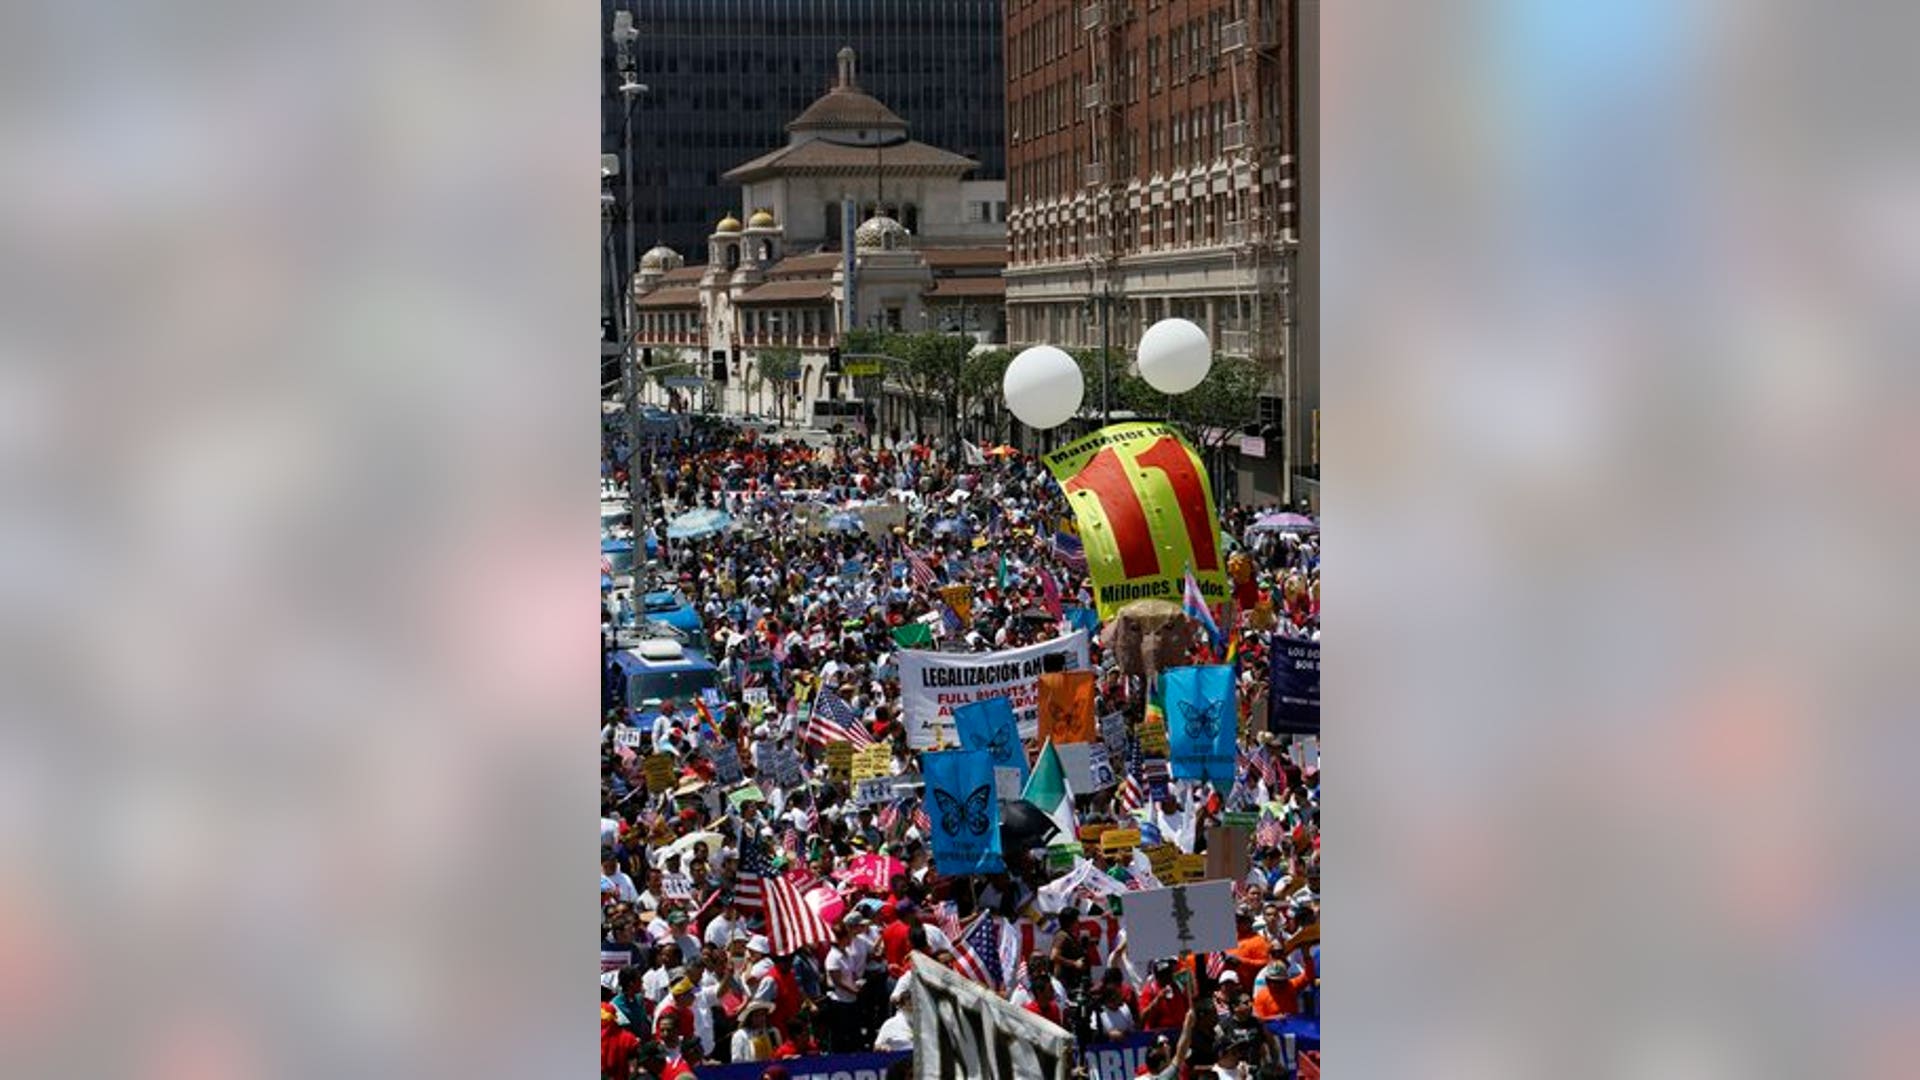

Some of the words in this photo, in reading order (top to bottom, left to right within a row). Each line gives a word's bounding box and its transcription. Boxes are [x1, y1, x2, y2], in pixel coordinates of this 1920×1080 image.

[1050, 430, 1145, 464] Mantener
[1064, 435, 1219, 579] 11
[1101, 580, 1170, 602] Millones
[1176, 578, 1224, 596] Udos
[937, 692, 971, 704] FULL
